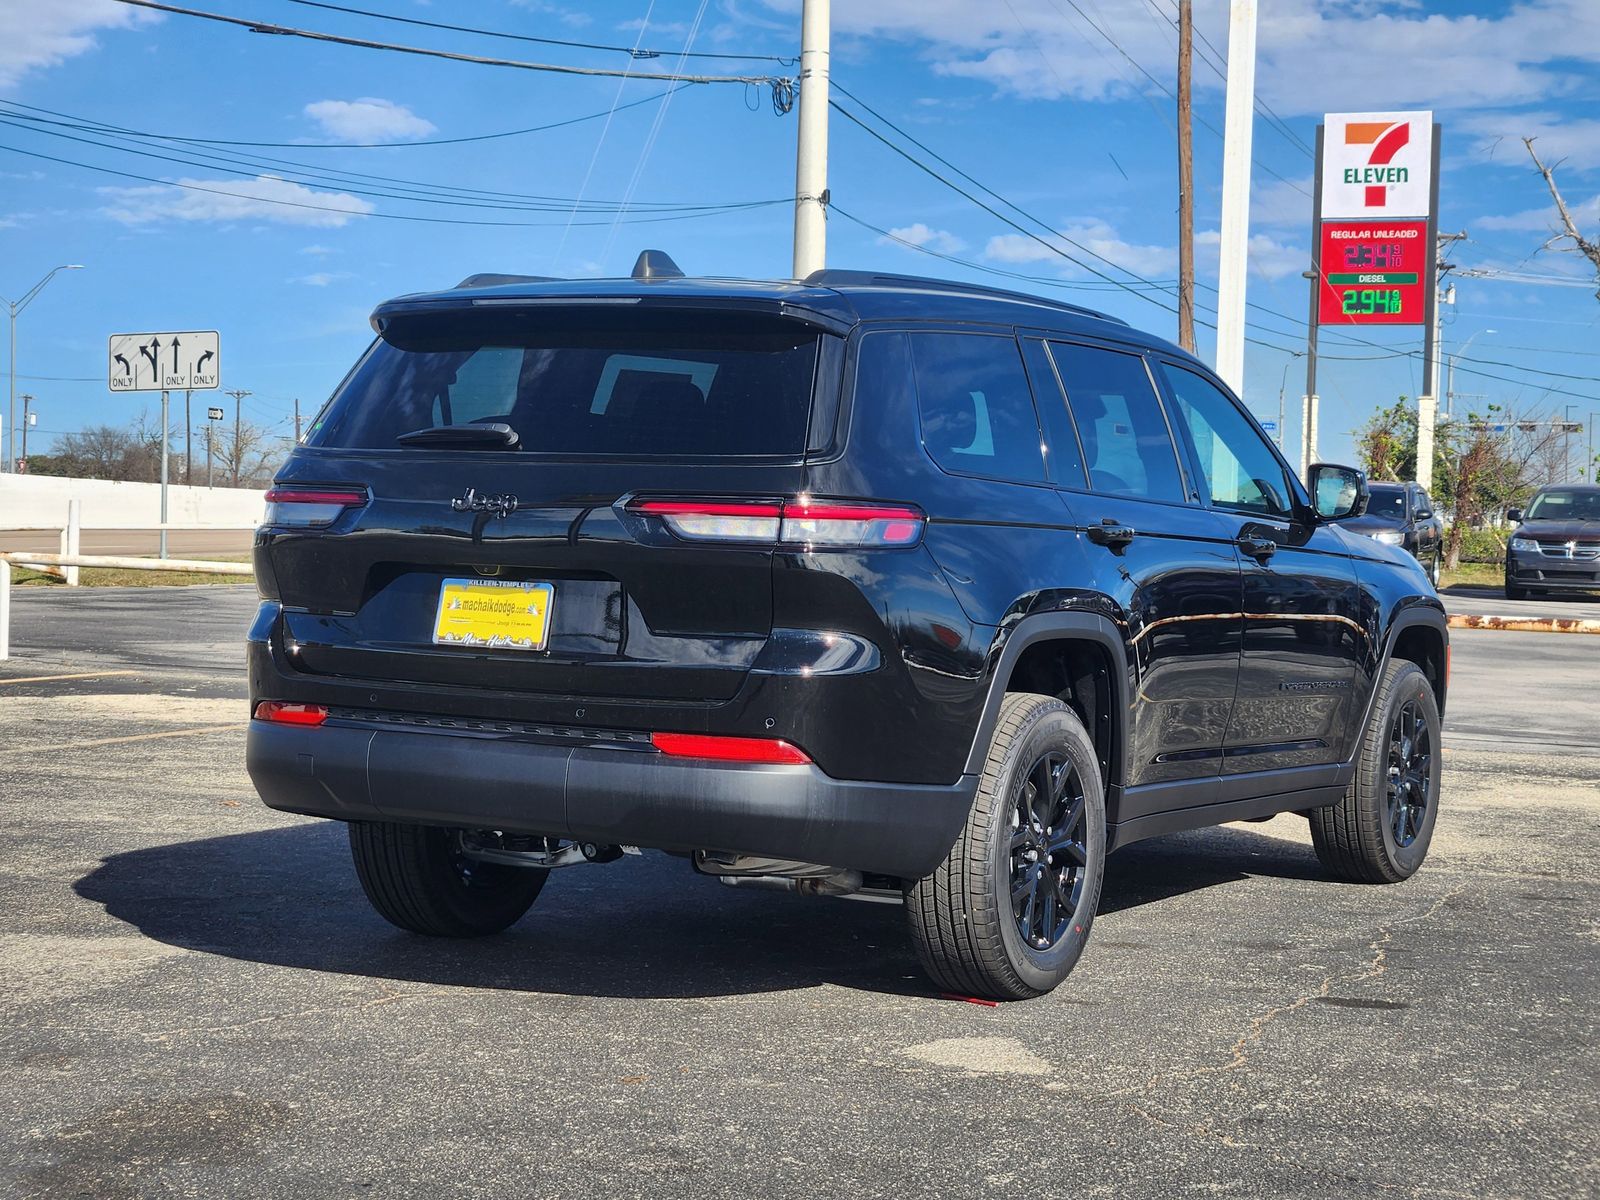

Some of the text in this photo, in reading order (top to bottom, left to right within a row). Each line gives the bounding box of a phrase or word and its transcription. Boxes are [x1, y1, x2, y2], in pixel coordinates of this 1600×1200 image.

[1331, 230, 1418, 239] REGULAR UNLEADED
[1358, 275, 1386, 283] DIESEL
[1342, 290, 1390, 314] 2.94
[112, 378, 133, 387] ONLY
[166, 376, 185, 385] ONLY
[193, 375, 215, 385] ONLY
[460, 632, 513, 648] Mac Haik
